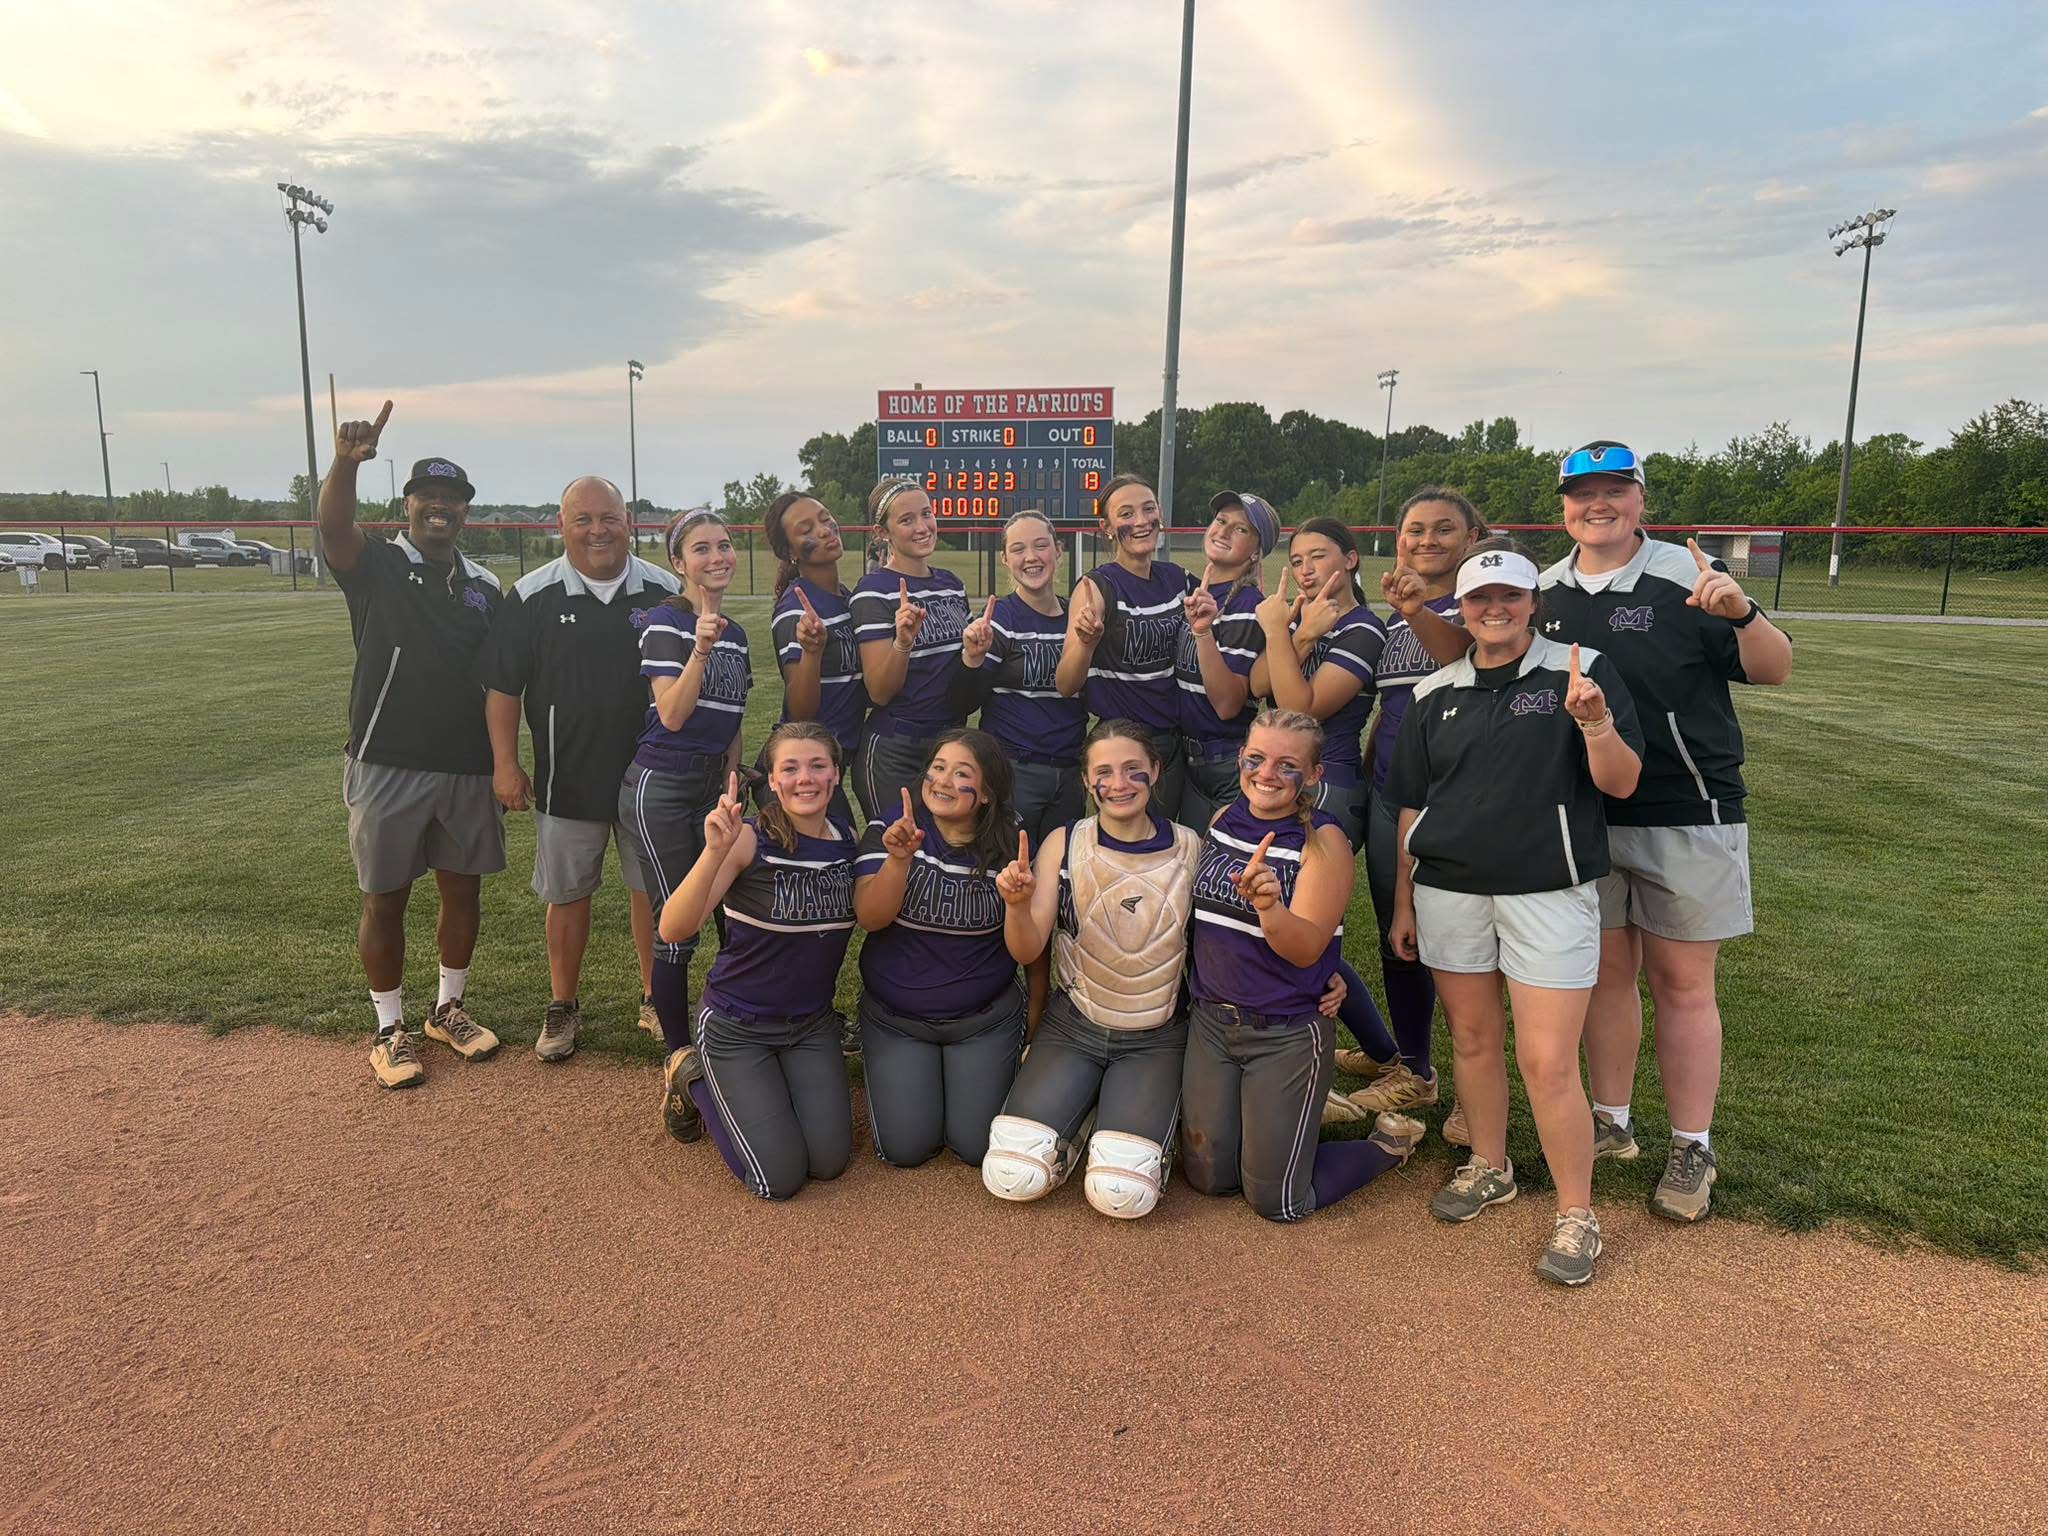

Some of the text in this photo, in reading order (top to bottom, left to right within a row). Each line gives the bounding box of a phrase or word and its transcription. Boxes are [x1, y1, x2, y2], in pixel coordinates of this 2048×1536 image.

[888, 392, 1104, 415] HOME OF THE PATRIOTS
[887, 427, 937, 447] BALL 0
[952, 427, 1015, 446] STRIKE 0
[1048, 426, 1095, 446] OUT 0
[1071, 458, 1106, 469] TOTAL
[926, 472, 938, 490] 2
[957, 472, 968, 490] 2
[973, 472, 984, 490] 3
[988, 472, 999, 490] 2
[1004, 472, 1015, 490] 3
[1084, 472, 1100, 490] 13
[942, 498, 952, 516] 0
[958, 498, 968, 516] 0
[972, 498, 984, 516] 0
[988, 498, 998, 516] 0
